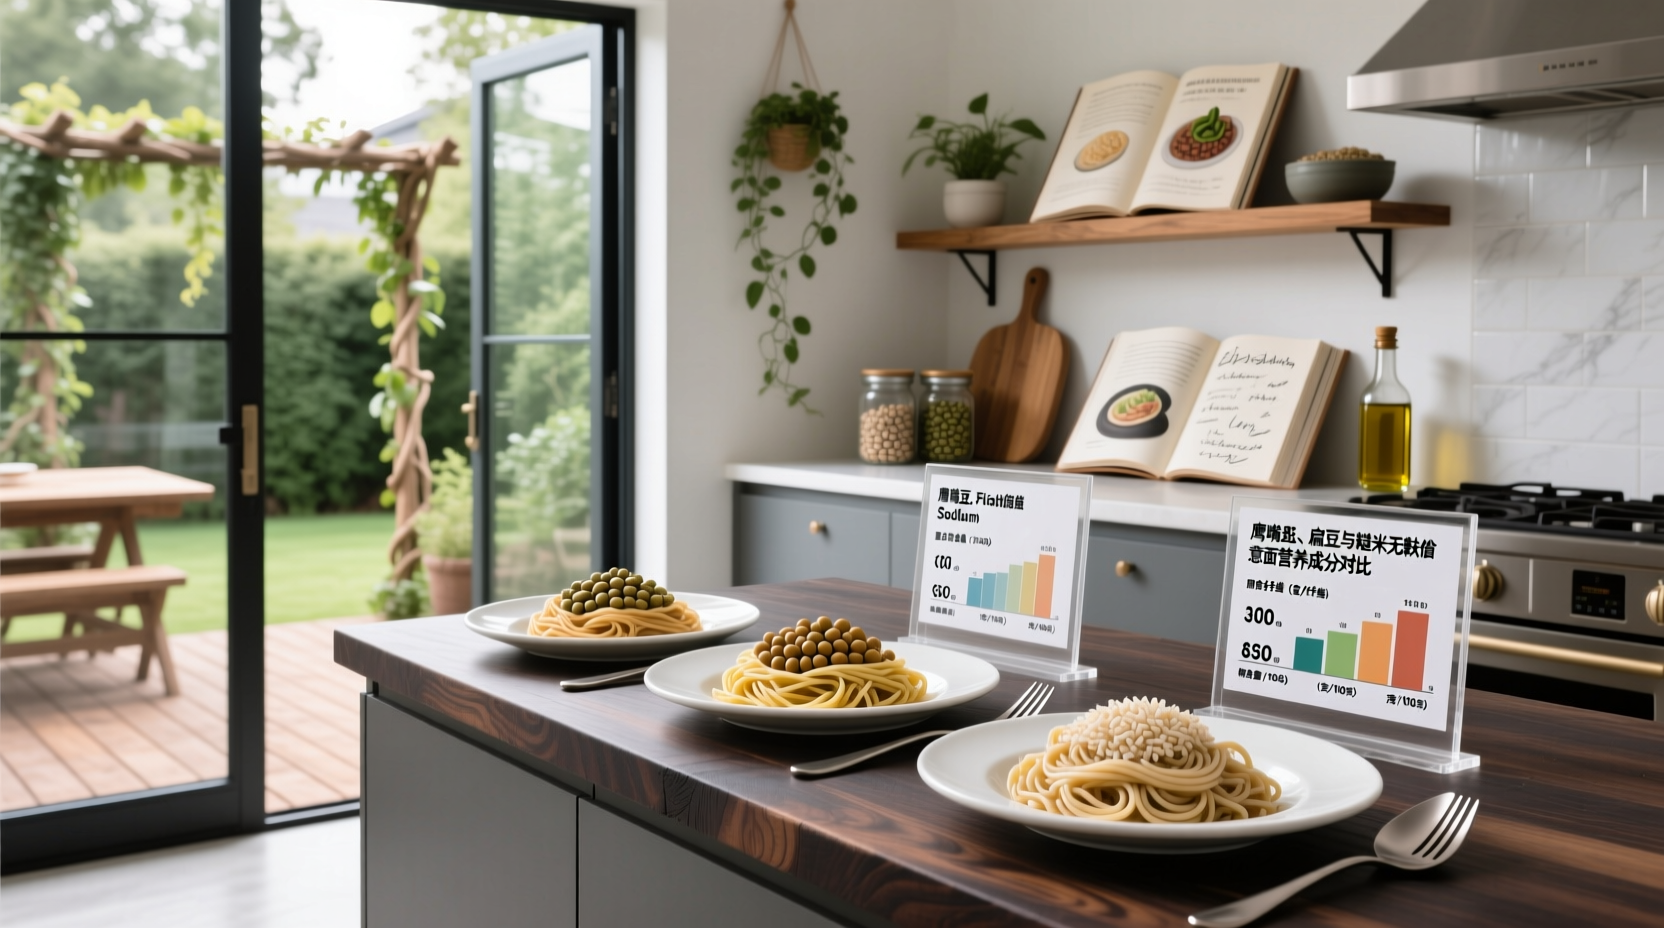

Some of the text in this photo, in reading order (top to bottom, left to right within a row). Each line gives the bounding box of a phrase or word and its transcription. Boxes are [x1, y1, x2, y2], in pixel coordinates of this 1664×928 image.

[1248, 546, 1371, 576] 意面营养成分对比
[1244, 606, 1275, 625] 300
